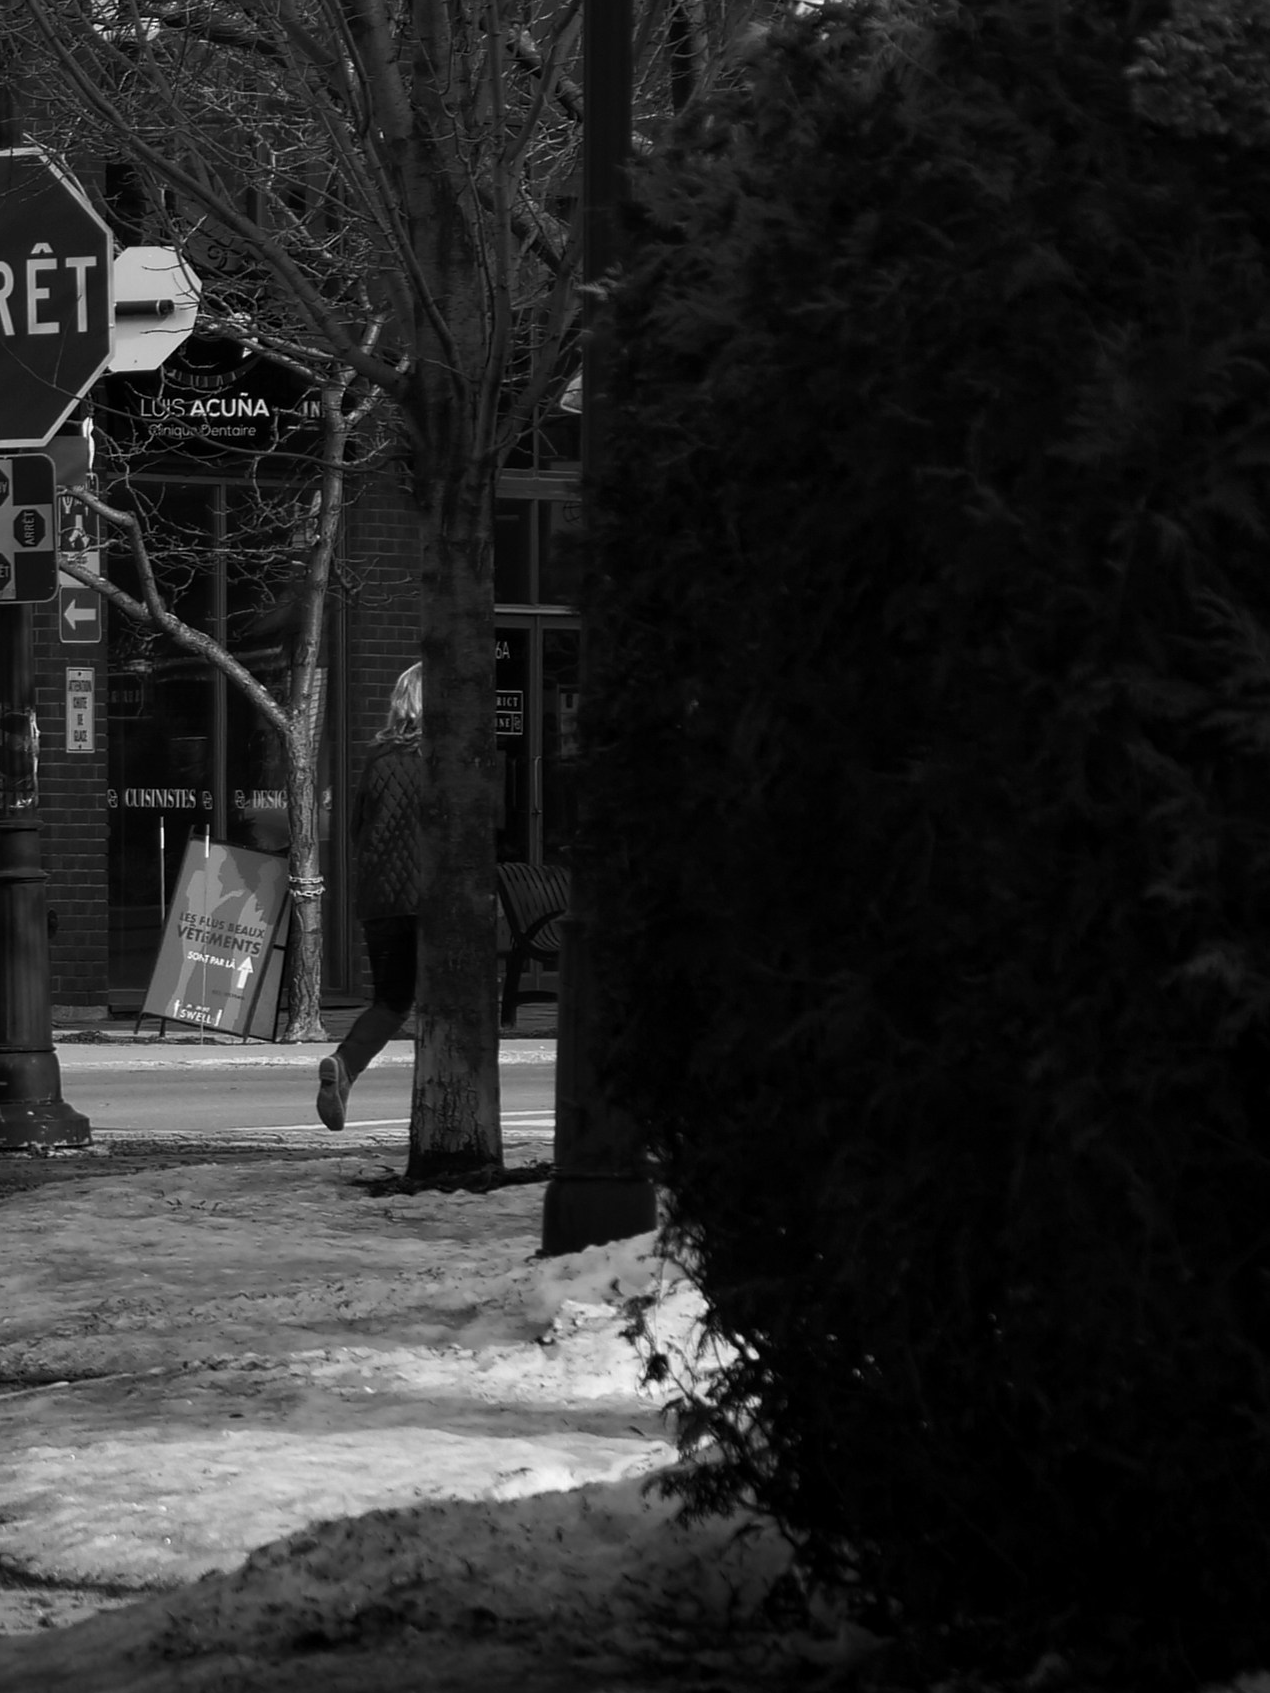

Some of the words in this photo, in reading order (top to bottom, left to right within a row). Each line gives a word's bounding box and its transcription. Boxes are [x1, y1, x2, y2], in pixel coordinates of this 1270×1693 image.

[140, 398, 186, 417] LUIS
[190, 392, 270, 417] ACUÑA
[200, 423, 257, 437] Dentaire
[21, 511, 35, 546] ARRÊT
[125, 788, 197, 809] CUISINISTES
[177, 924, 262, 956] VÊTEMENTS
[228, 922, 265, 939] BEAUX
[179, 1008, 212, 1025] SWELL
